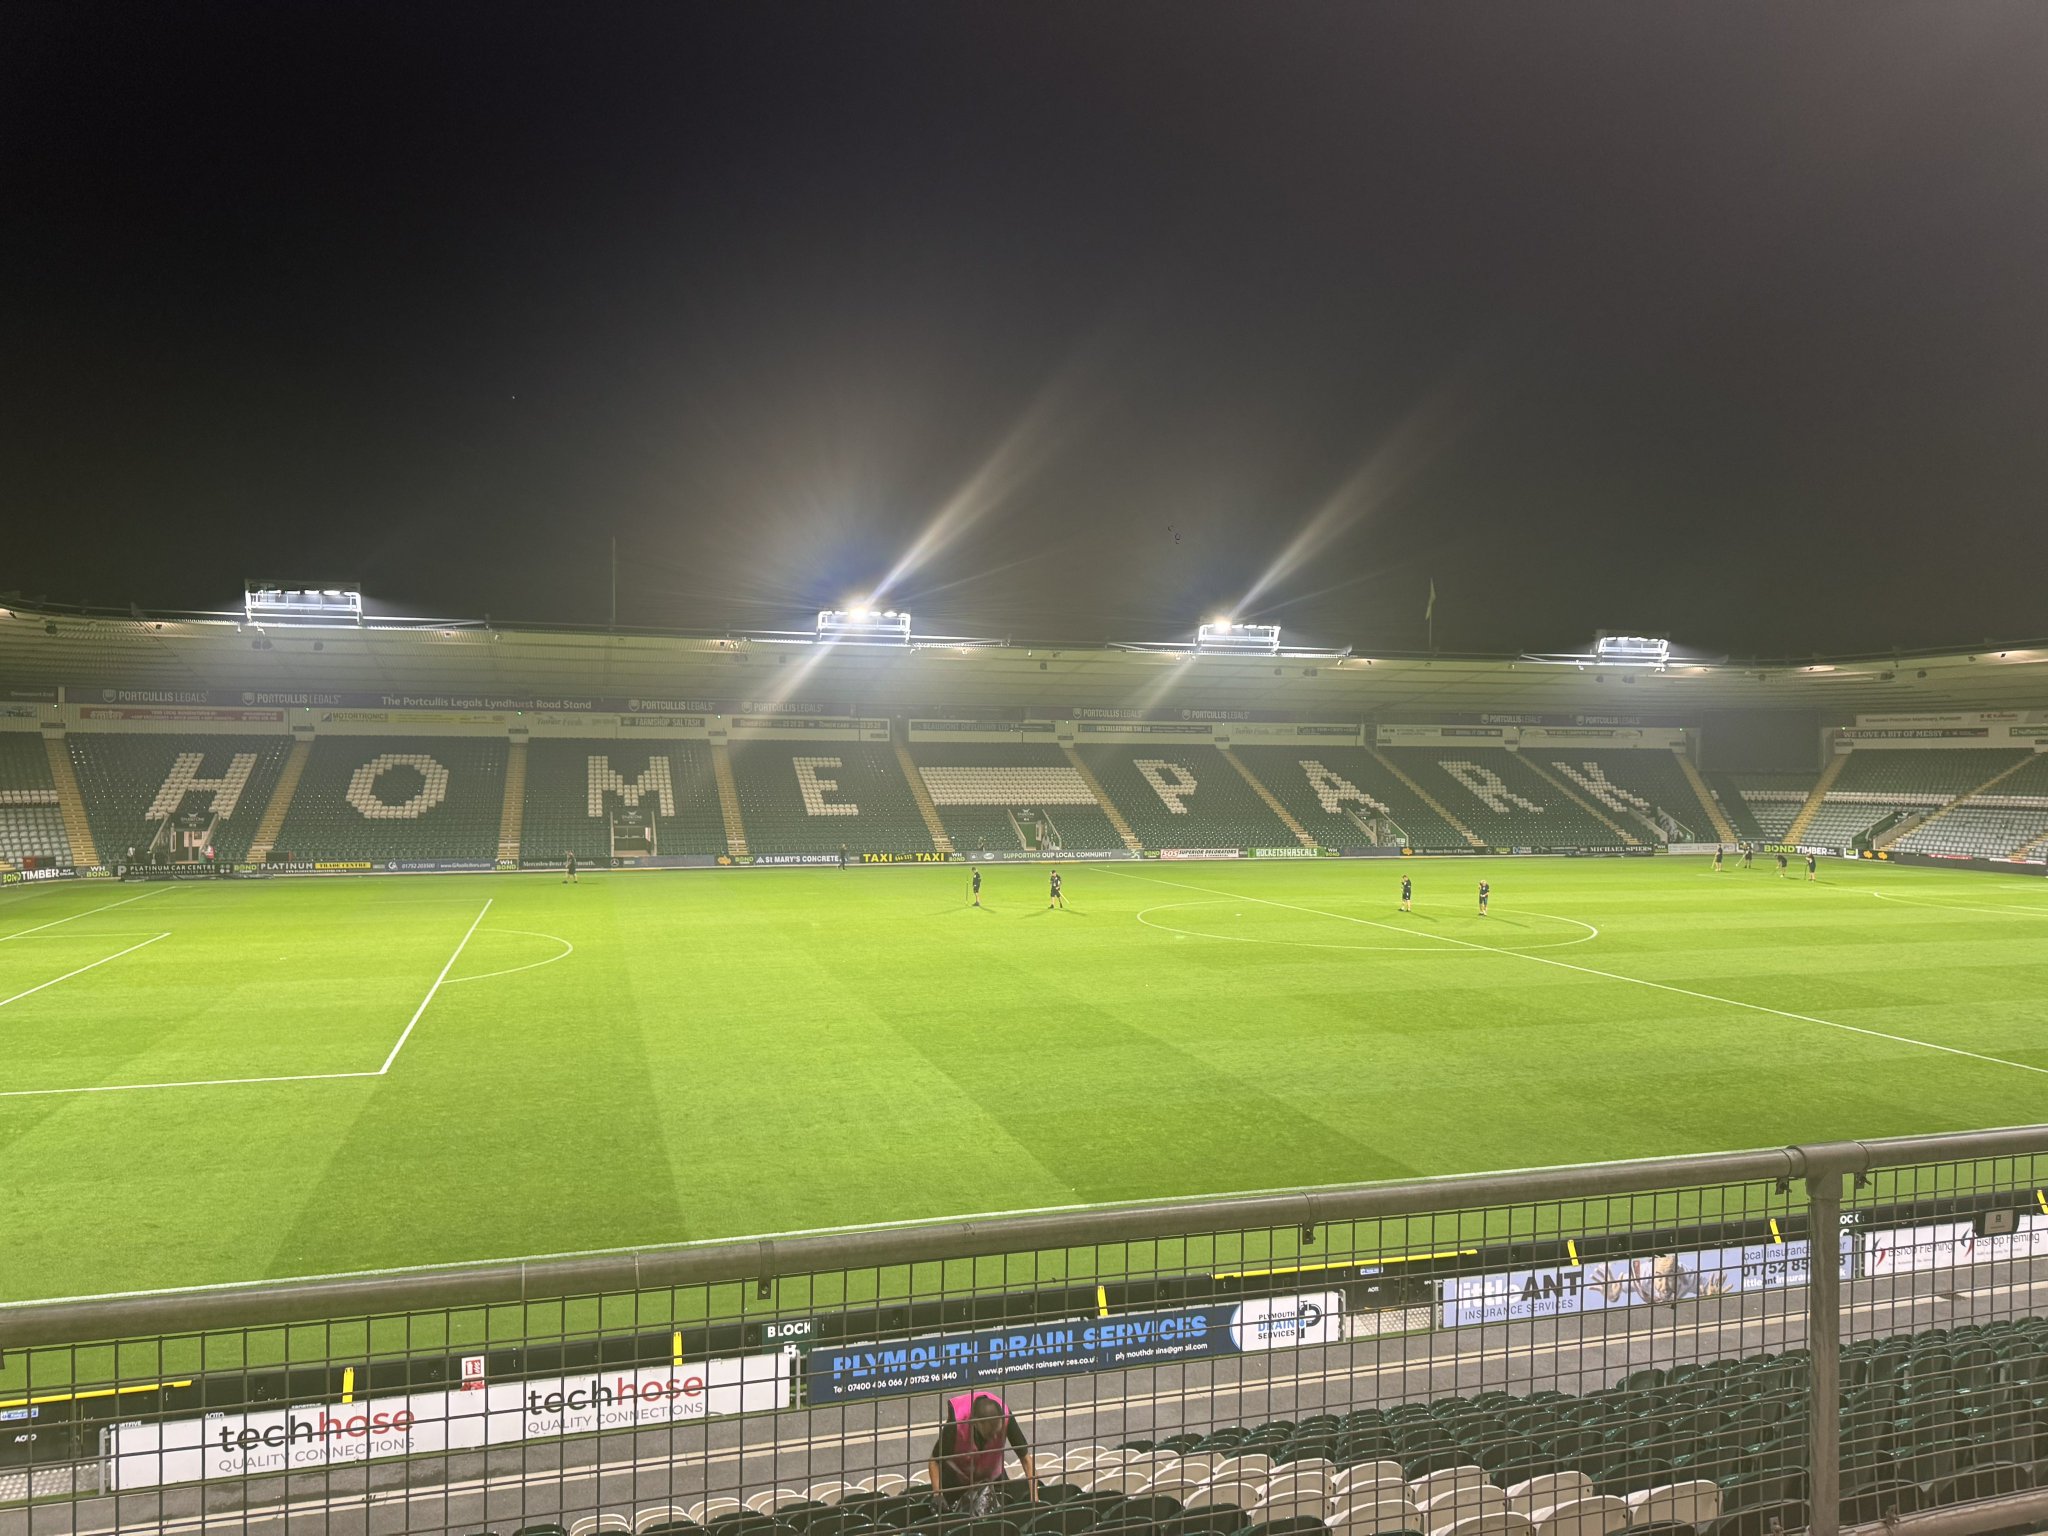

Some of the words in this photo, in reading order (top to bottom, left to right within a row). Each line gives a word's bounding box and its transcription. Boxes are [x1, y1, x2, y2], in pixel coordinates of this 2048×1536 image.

[119, 691, 173, 702] PORTCULLIS
[257, 693, 308, 704] PORTCULLIS
[382, 696, 401, 706] The
[403, 697, 449, 707] Portcullis
[451, 699, 482, 709] Legals
[485, 699, 534, 710] Lyndhurst
[537, 700, 561, 709] Road
[563, 701, 592, 709] Stand
[641, 701, 686, 711] PORTCULLIS
[1083, 708, 1120, 718] PORTCULLIS
[1858, 730, 1879, 738] LOVE
[1880, 730, 1887, 738] A
[1888, 730, 1902, 738] BIT
[1903, 729, 1915, 737] OF
[1916, 729, 1943, 737] MESSY
[1162, 849, 1178, 857] SOS
[1764, 845, 1795, 854] BOND
[1795, 846, 1827, 856] TIMBER
[863, 854, 893, 863] TAXI
[916, 852, 945, 862] TAXI
[21, 868, 60, 881] TIMBER
[2006, 1232, 2040, 1245] Feming
[1888, 1246, 1917, 1259] Bshop
[1743, 1260, 1787, 1277] 0152
[1455, 1271, 1583, 1310] littleANT
[1465, 1304, 1523, 1321] INSURANCE
[1526, 1299, 1574, 1313] SERVICES
[767, 1321, 812, 1338] BLOCK
[833, 1340, 979, 1380] PLYMOUTH
[989, 1328, 1074, 1361] DRAIN
[888, 1378, 903, 1388] 066
[909, 1374, 930, 1385] 01752
[527, 1375, 704, 1416] techhose
[527, 1415, 592, 1435] QUALITY
[595, 1401, 704, 1425] CONNECTIONS
[218, 1409, 415, 1453] techhose
[14, 1433, 38, 1443] AOO
[218, 1452, 289, 1473] QUALITY
[294, 1436, 415, 1463] CONNECTIONS
